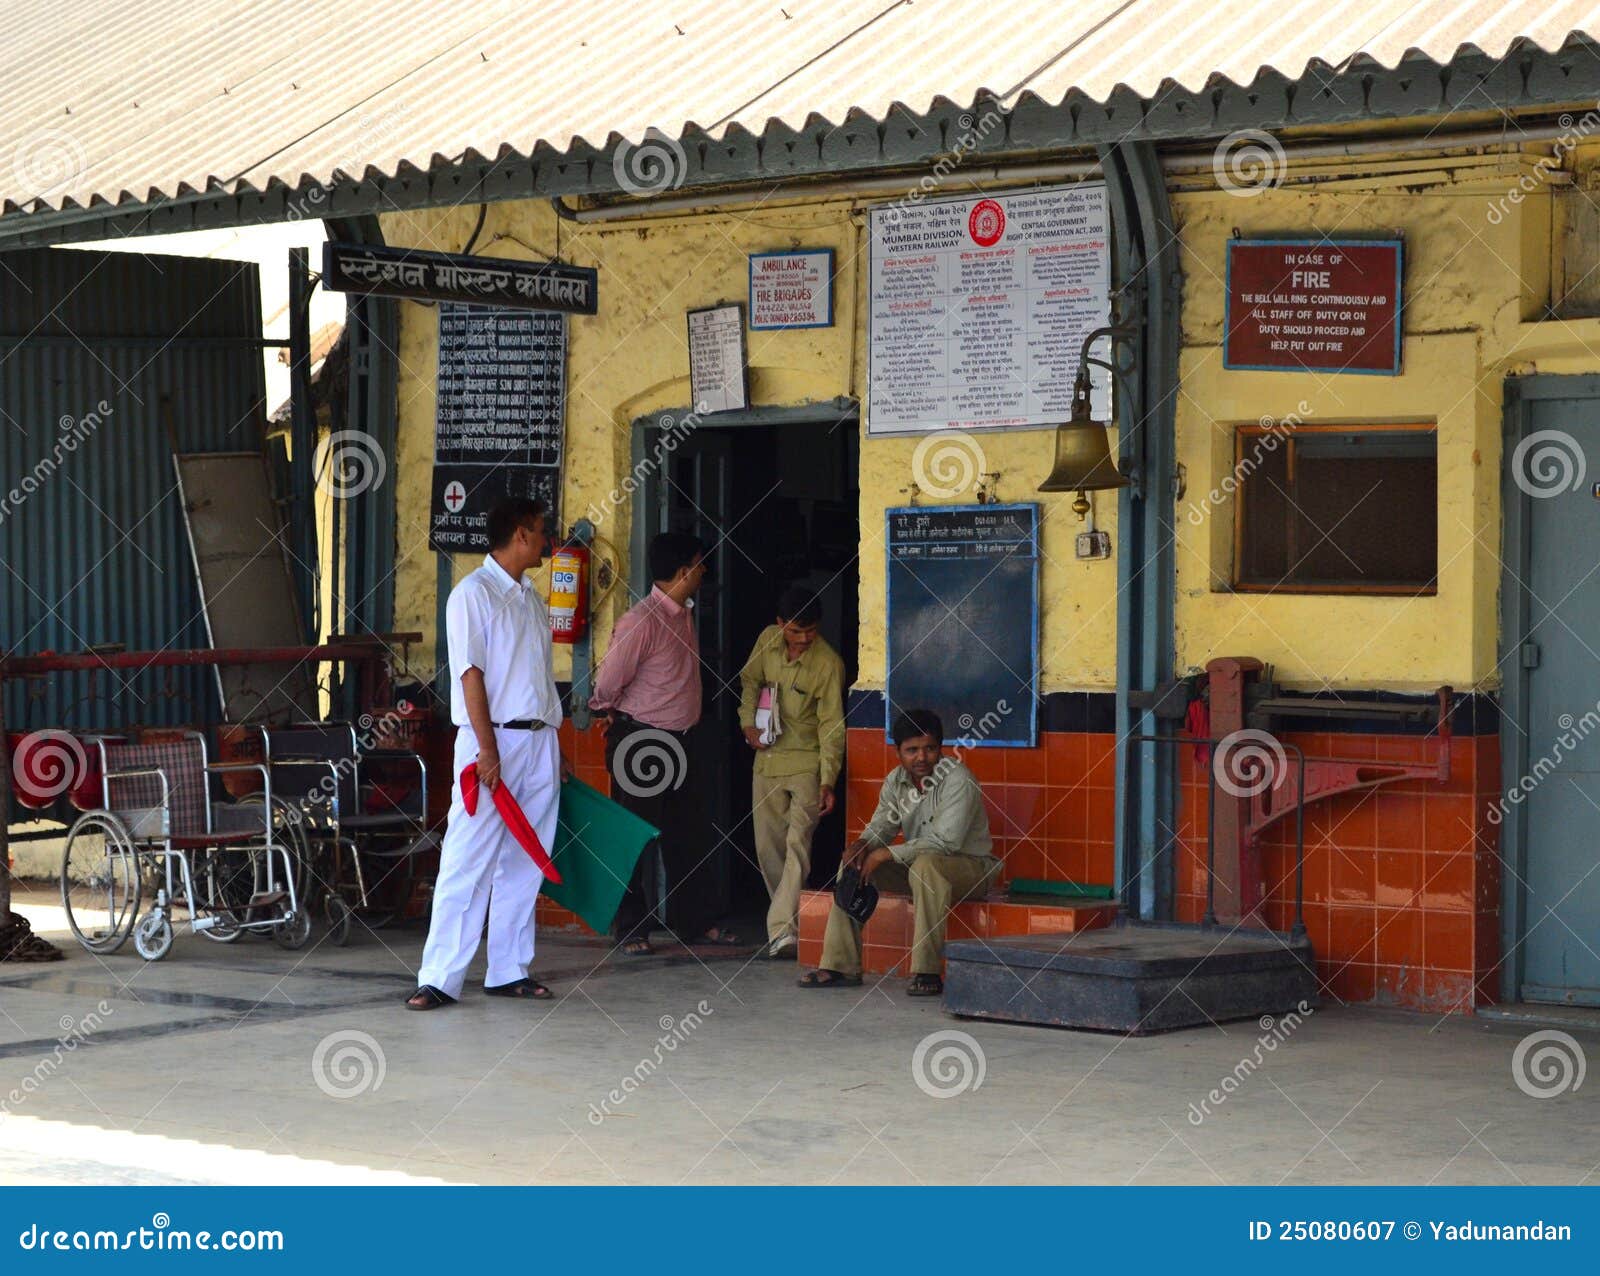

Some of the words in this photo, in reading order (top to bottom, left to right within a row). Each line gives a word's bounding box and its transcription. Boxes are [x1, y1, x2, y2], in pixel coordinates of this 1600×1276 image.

[1047, 217, 1087, 228] GOVERNMENT
[882, 233, 921, 245] MUMBAI
[923, 229, 965, 241] DIVISION,
[1006, 233, 1023, 242] RIGHT
[1033, 228, 1075, 239] INFORMATION
[1089, 225, 1103, 235] 2005
[887, 242, 923, 253] WESTERN
[924, 239, 960, 250] RAILWAY
[761, 258, 807, 273] AMBULANCE
[1285, 254, 1295, 264] IN
[1297, 254, 1324, 265] CASE
[1329, 255, 1343, 265] OF
[339, 252, 430, 288] स्टेशन
[431, 262, 514, 297] मास्टर
[514, 270, 588, 306] कार्यालय
[1291, 271, 1331, 289] FIRE
[756, 289, 771, 302] FIRE
[774, 287, 812, 302] BRIGADES
[1241, 294, 1253, 303] THE
[1254, 294, 1271, 304] BELL
[1273, 294, 1290, 304] WILL
[1290, 294, 1308, 304] RING
[1310, 294, 1369, 305] CONTINUOUSLY
[1371, 295, 1387, 305] AND
[1252, 309, 1267, 319] ALL
[1270, 310, 1294, 319] STAFF
[1296, 310, 1312, 319] OFF
[1316, 311, 1337, 320] DUTY
[1339, 311, 1352, 321] OR
[1353, 311, 1367, 321] ON
[1259, 325, 1280, 335] DUTY
[1283, 325, 1312, 335] SHOULD
[1314, 326, 1349, 336] PROCEED
[1350, 327, 1366, 336] AND
[1271, 341, 1289, 350] HELP
[1290, 341, 1305, 351] PUT
[1308, 341, 1325, 351] OUT
[1326, 342, 1343, 352] FIRE
[434, 531, 466, 545] सहायता
